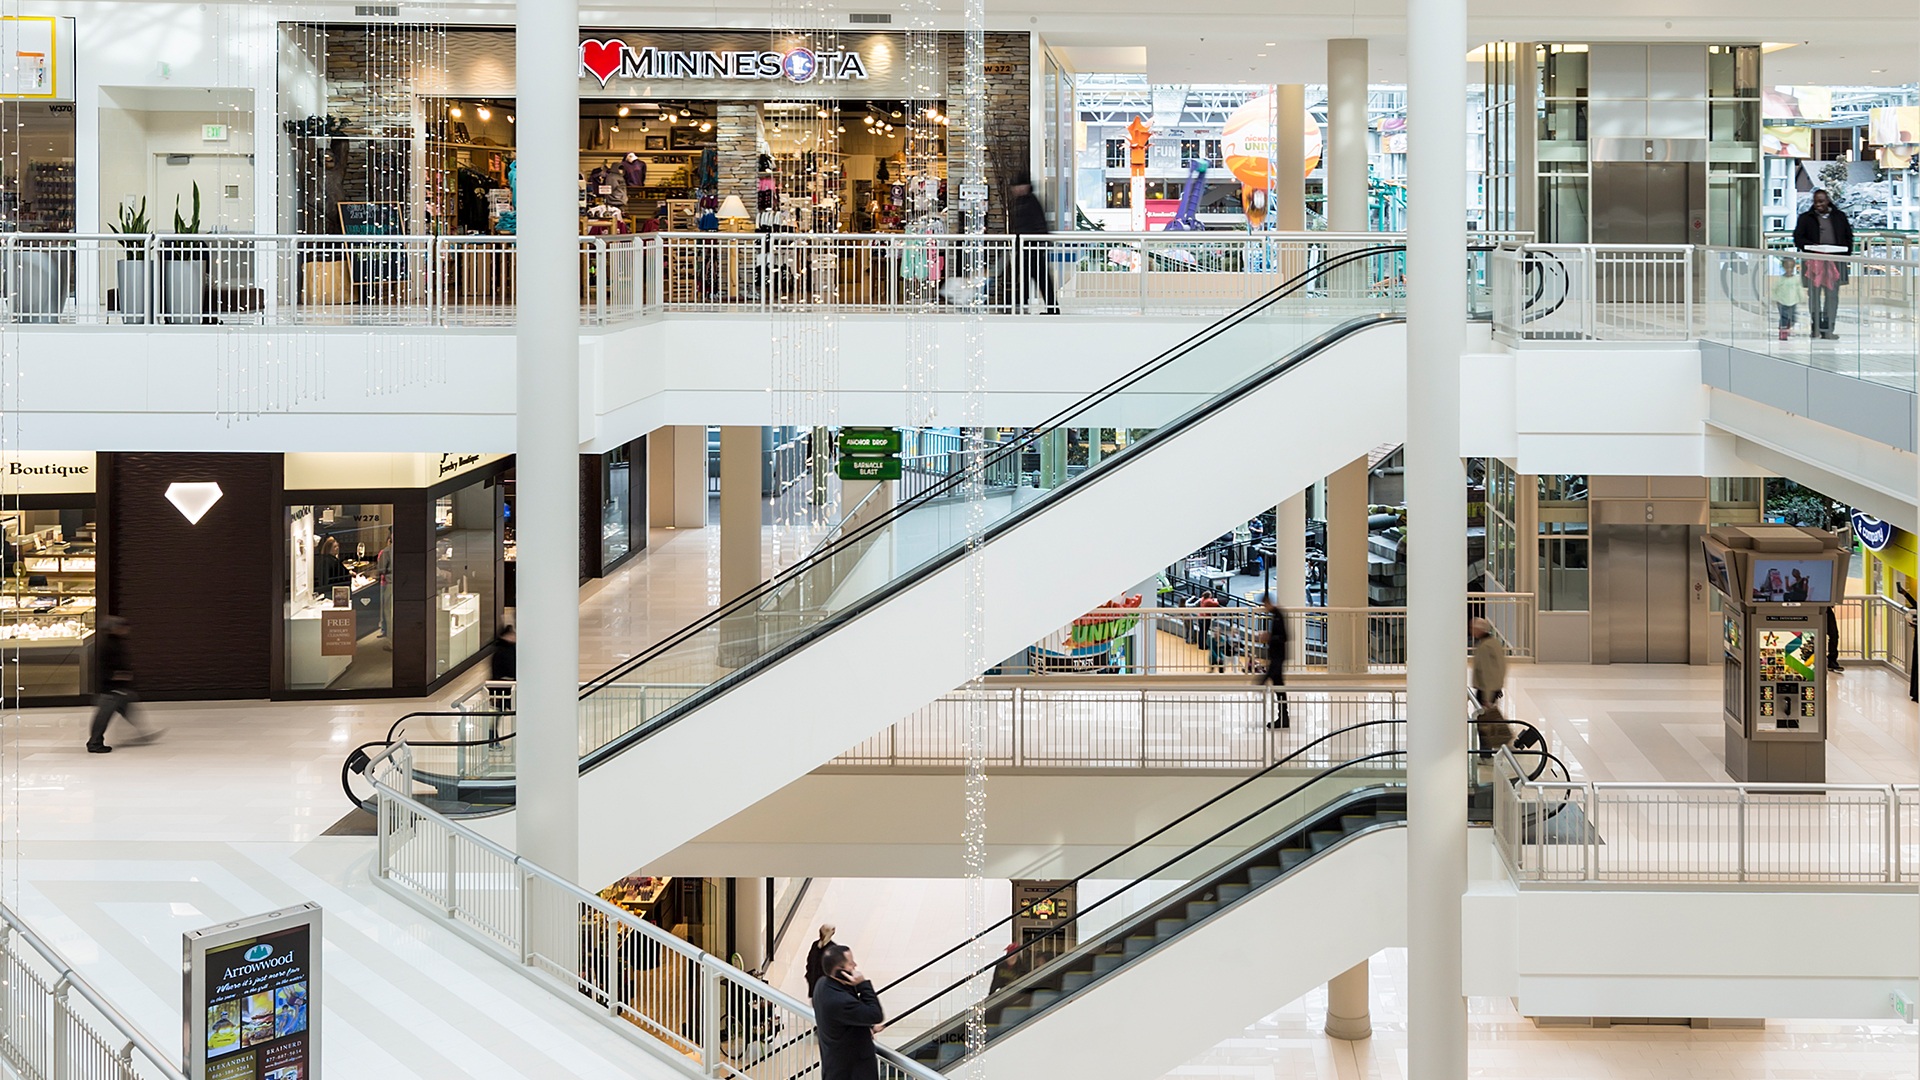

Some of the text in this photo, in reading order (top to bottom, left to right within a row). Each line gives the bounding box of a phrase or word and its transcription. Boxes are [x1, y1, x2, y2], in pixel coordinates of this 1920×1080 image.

[619, 46, 869, 83] MINNESOTA
[1154, 146, 1177, 158] FUN
[9, 462, 90, 478] Boutique
[353, 514, 380, 522] W278
[1862, 526, 1884, 546] company
[327, 618, 351, 627] FREE
[223, 951, 293, 980] Arrowwood
[215, 967, 300, 994] Where it's just more fun
[266, 1040, 302, 1056] BRAINERD
[207, 1054, 254, 1073] ALEXANDRIA
